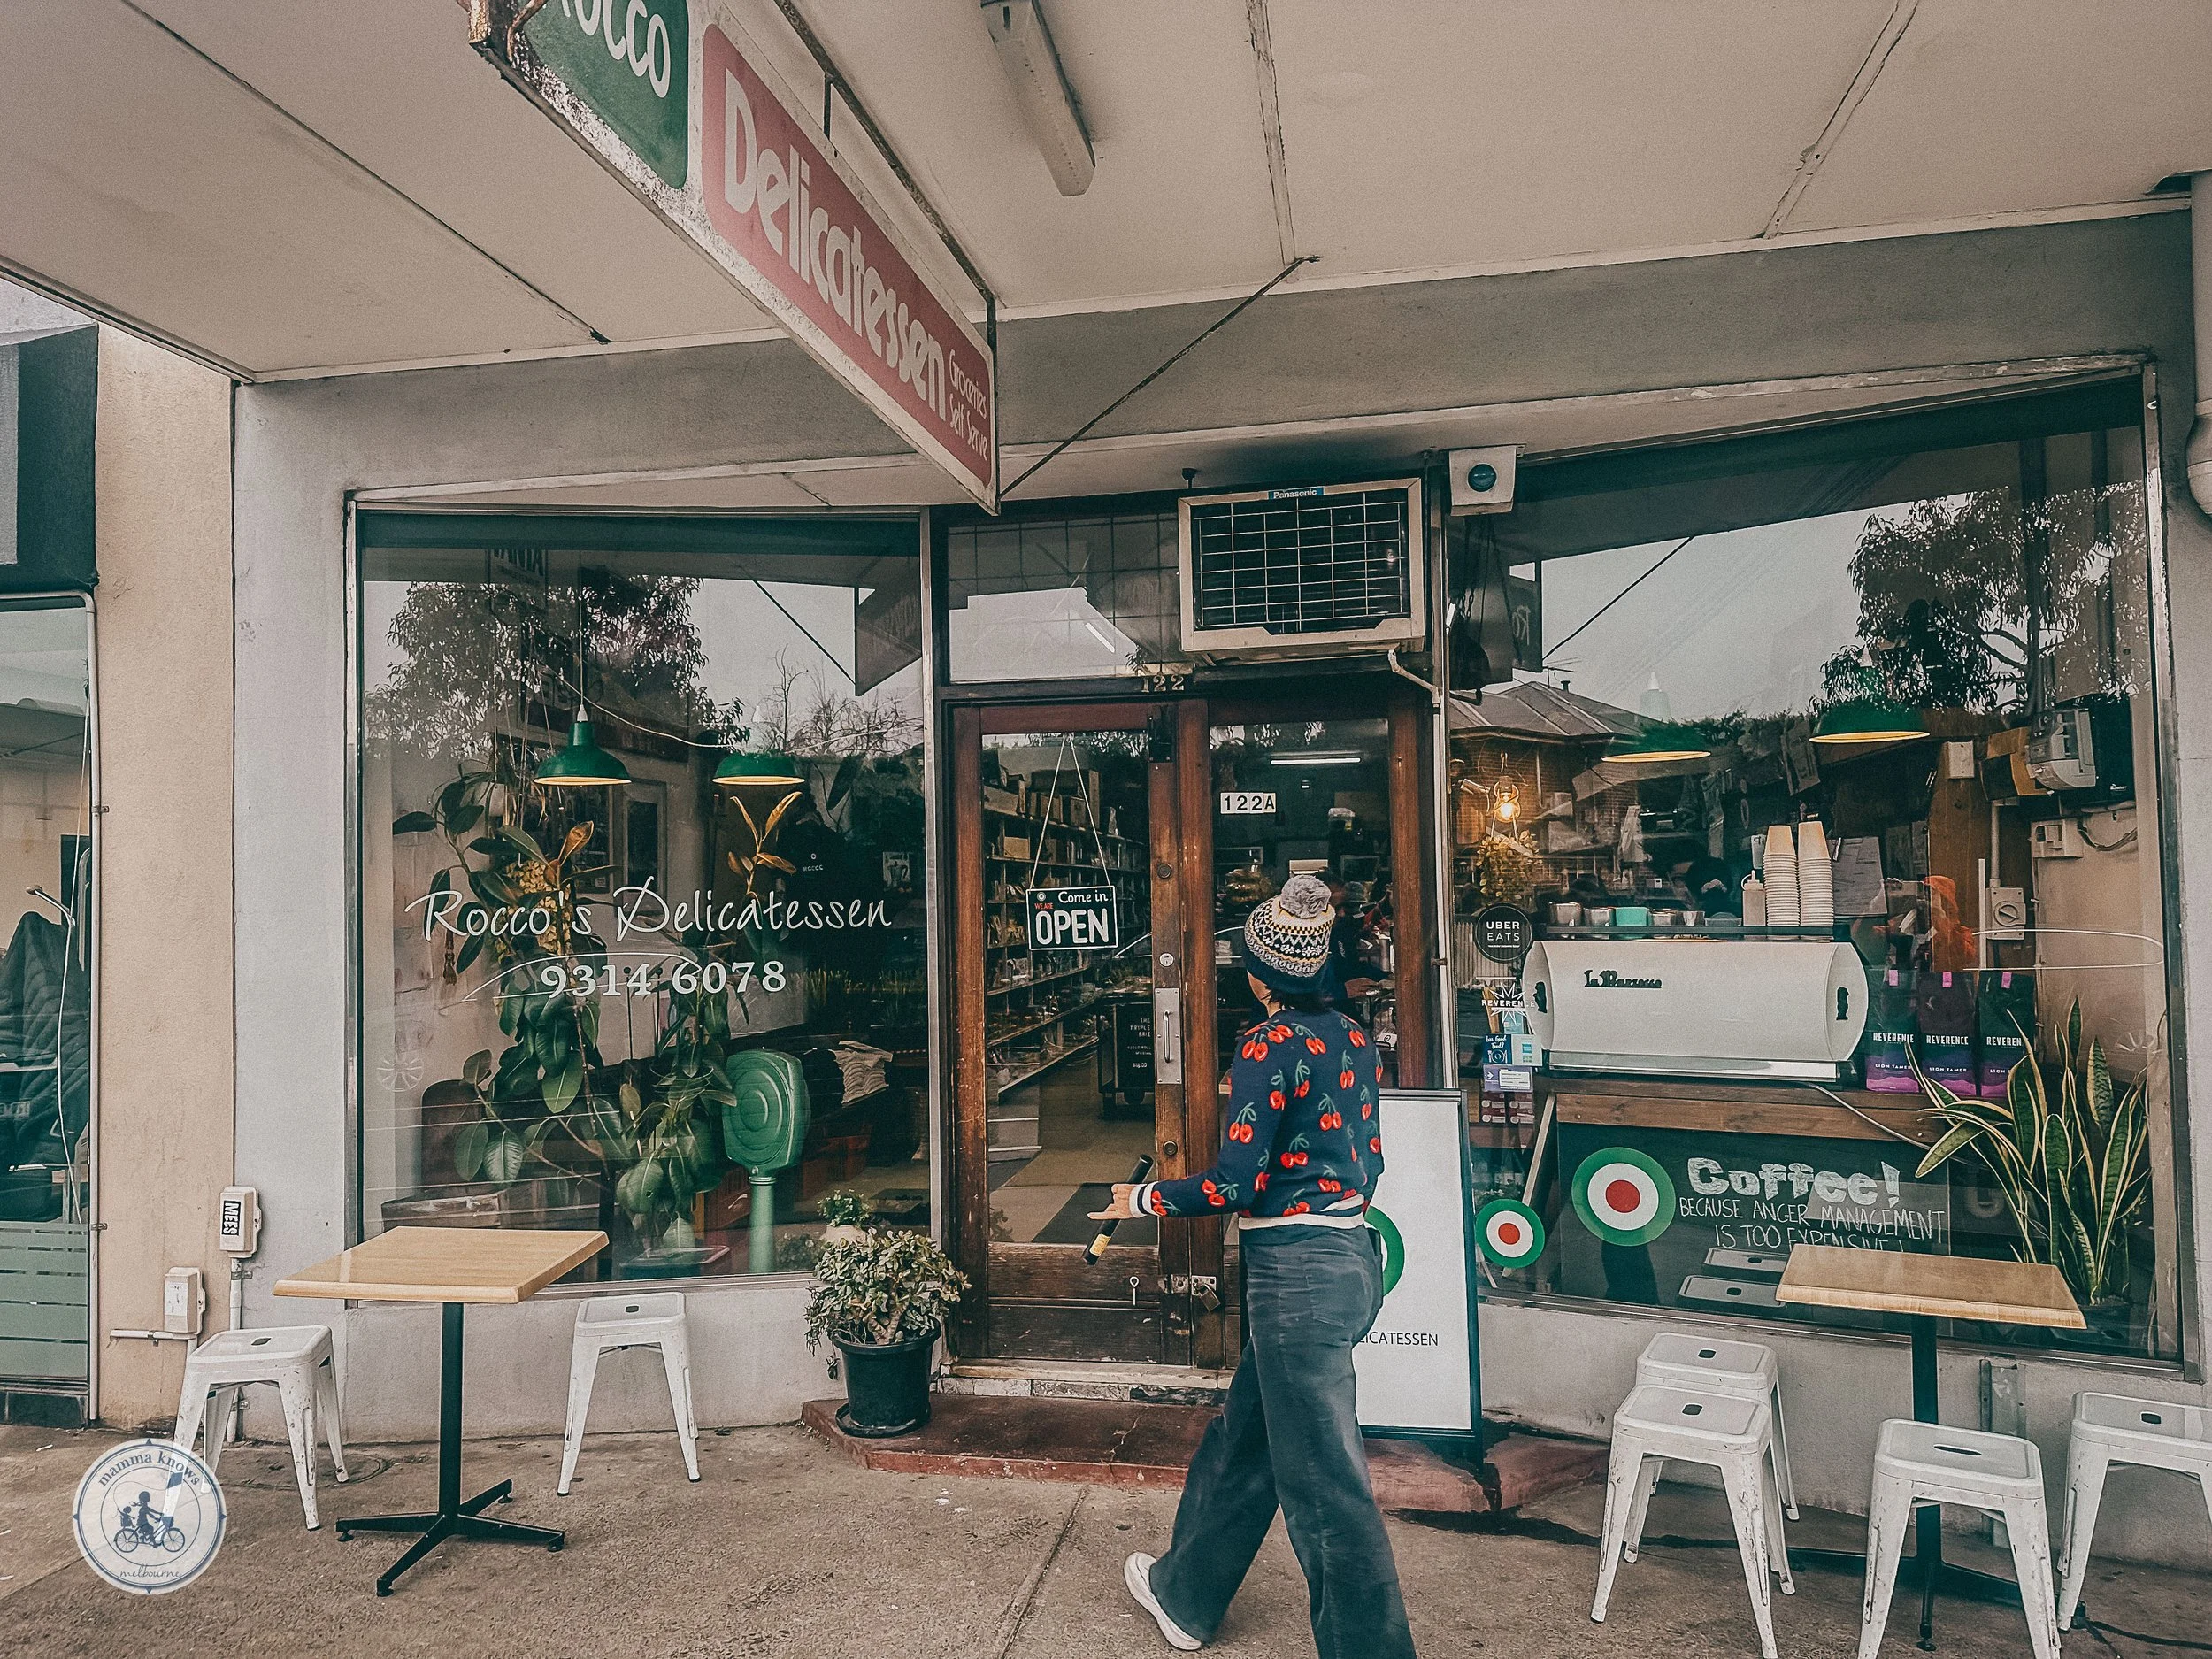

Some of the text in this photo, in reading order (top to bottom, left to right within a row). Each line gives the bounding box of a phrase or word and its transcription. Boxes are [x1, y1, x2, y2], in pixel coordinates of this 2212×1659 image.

[725, 67, 946, 422] Delicatessen
[949, 349, 987, 419] Groceries
[949, 392, 987, 461] Self Serve
[1273, 488, 1317, 499] Panasonic
[1141, 674, 1185, 693] 122
[1224, 795, 1275, 811] 122A
[1057, 889, 1109, 903] Come in
[404, 875, 892, 942] Rocco's Delicatessen
[1035, 908, 1110, 945] OPEN
[1486, 921, 1520, 930] UBER
[1486, 933, 1520, 941] EATS
[541, 960, 787, 999] 9314 6078
[1481, 999, 1536, 1008] REVERENCE
[1872, 1032, 1915, 1043] REVERENCE
[1926, 1035, 1969, 1046] REVERENCE
[1986, 1036, 2023, 1047] REVEREN
[1687, 1157, 1901, 1209] Coffee!
[223, 1202, 241, 1235] MEES
[1679, 1197, 1946, 1243] BECAUSE ANGER MANAGEMENT
[1715, 1225, 1737, 1249] IS
[1740, 1224, 1781, 1248] TOO
[1358, 1331, 1439, 1347] ICATESSEN
